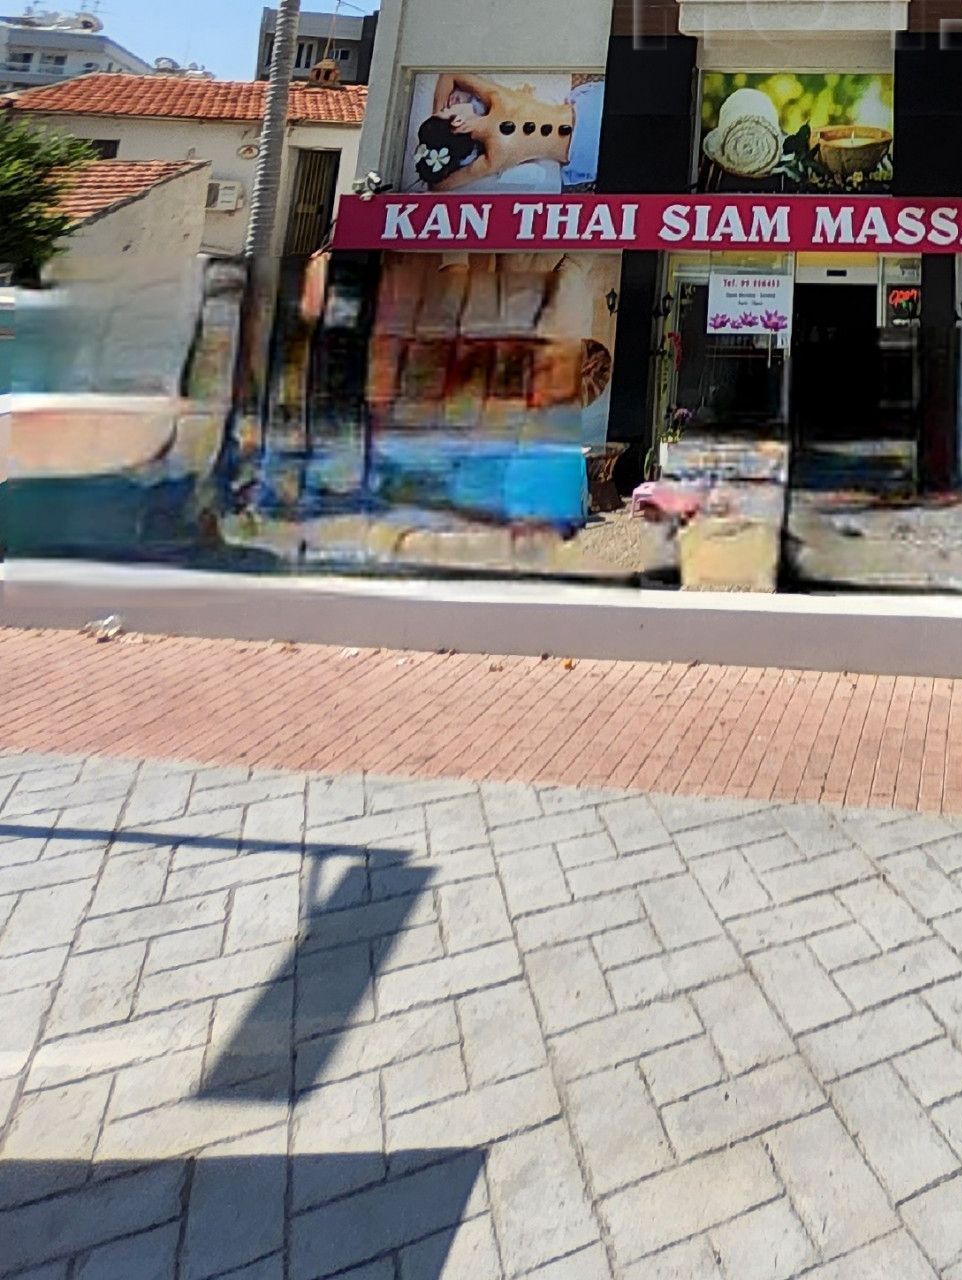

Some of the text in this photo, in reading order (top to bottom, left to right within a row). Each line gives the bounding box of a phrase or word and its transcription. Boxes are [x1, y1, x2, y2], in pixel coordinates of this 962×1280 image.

[381, 203, 492, 240] KAN
[513, 203, 637, 241] THAI
[659, 205, 791, 243] SIAM
